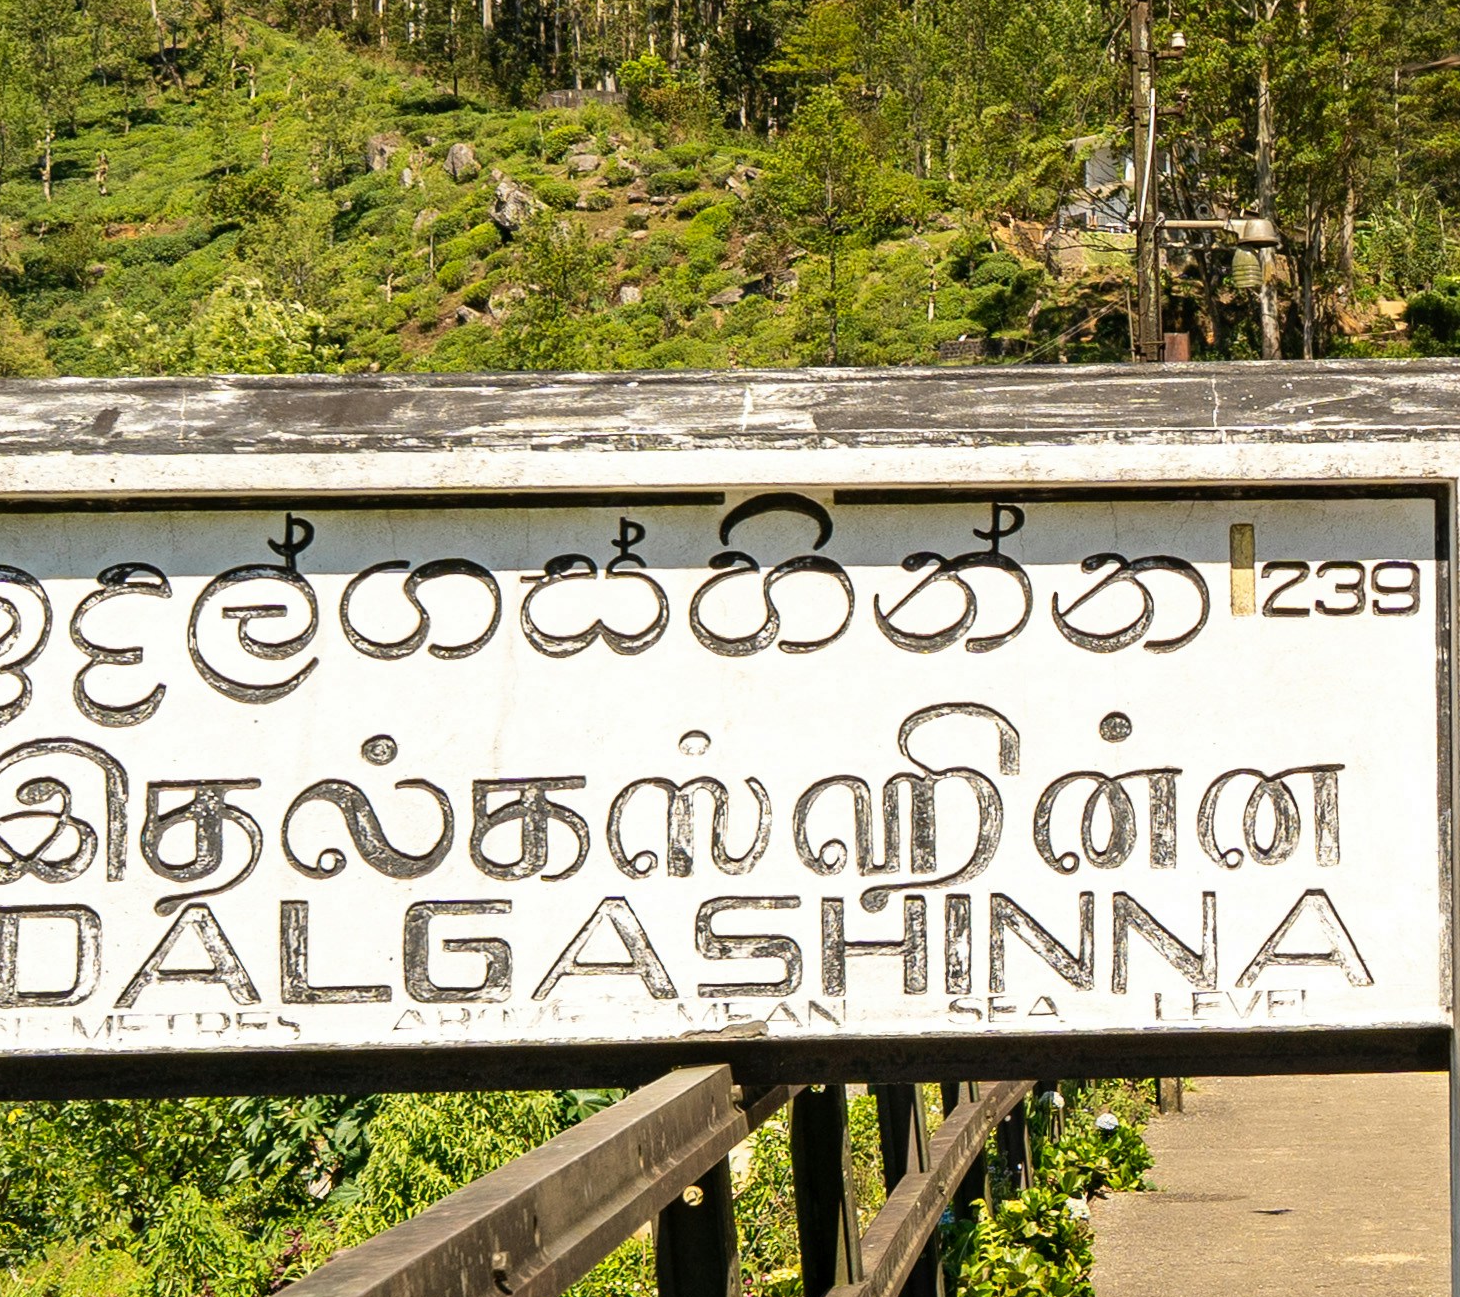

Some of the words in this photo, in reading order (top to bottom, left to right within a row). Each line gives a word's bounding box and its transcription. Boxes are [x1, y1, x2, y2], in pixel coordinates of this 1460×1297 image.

[1261, 560, 1421, 618] 239
[71, 1011, 301, 1044] METRES
[676, 999, 847, 1029] MEAN
[947, 995, 1066, 1025] SEA
[1154, 988, 1316, 1022] LEVEL
